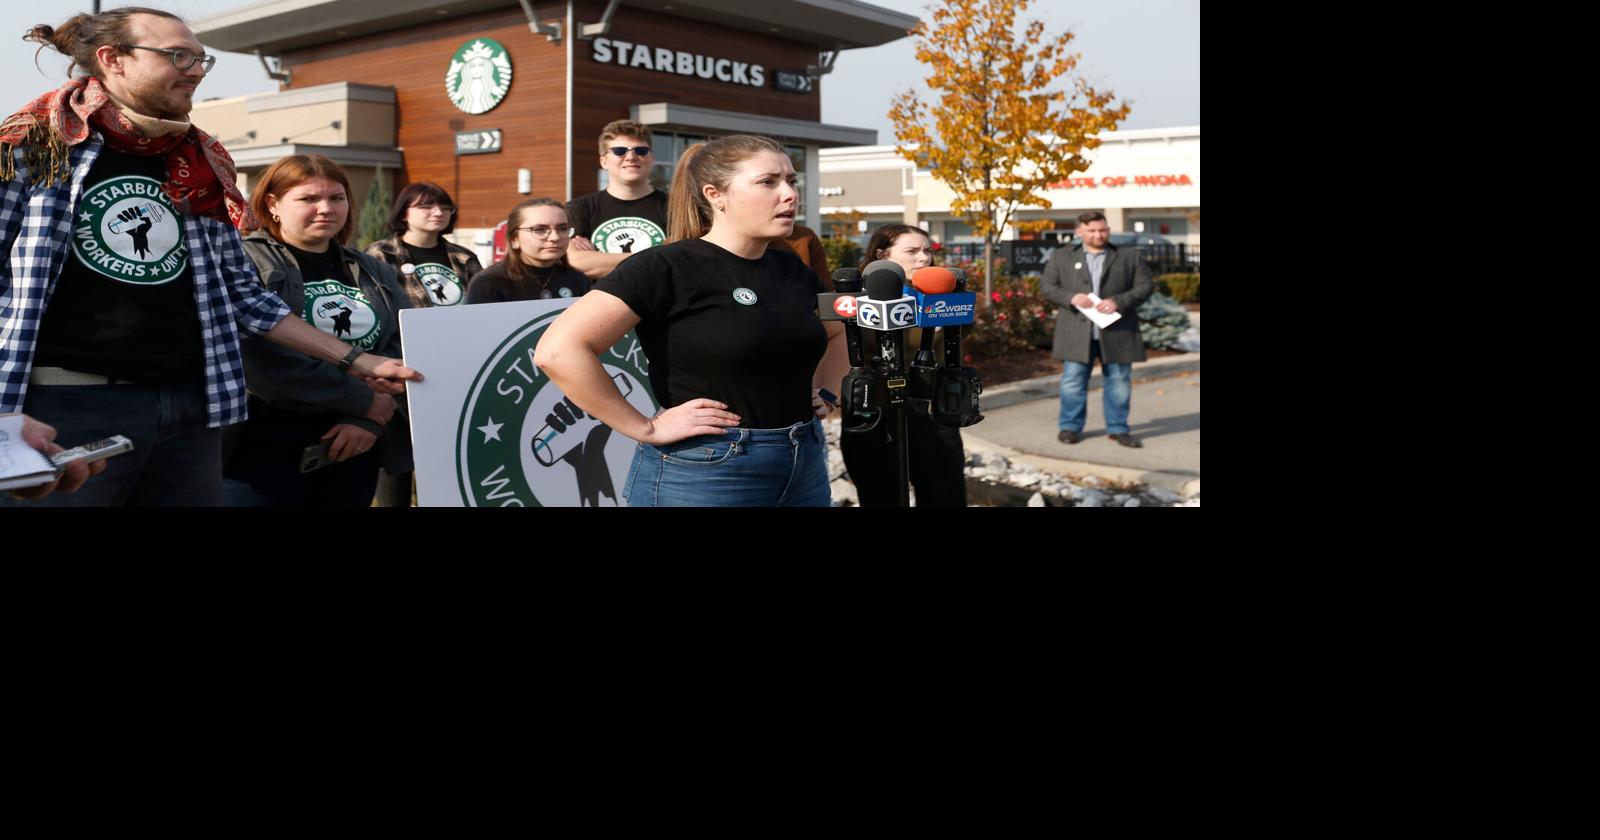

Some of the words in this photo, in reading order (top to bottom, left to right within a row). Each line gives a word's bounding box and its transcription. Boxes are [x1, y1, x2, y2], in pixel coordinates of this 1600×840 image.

[592, 37, 765, 87] STARBUCKS
[456, 132, 480, 143] DRIVE
[457, 140, 479, 150] THRU
[1101, 176, 1127, 186] OF
[1134, 174, 1192, 185] INDIA
[602, 220, 659, 237] STARBUCKS
[75, 225, 146, 277] WORKERS
[837, 298, 857, 314] 4
[935, 300, 946, 313] 2
[945, 304, 973, 312] WGRZ
